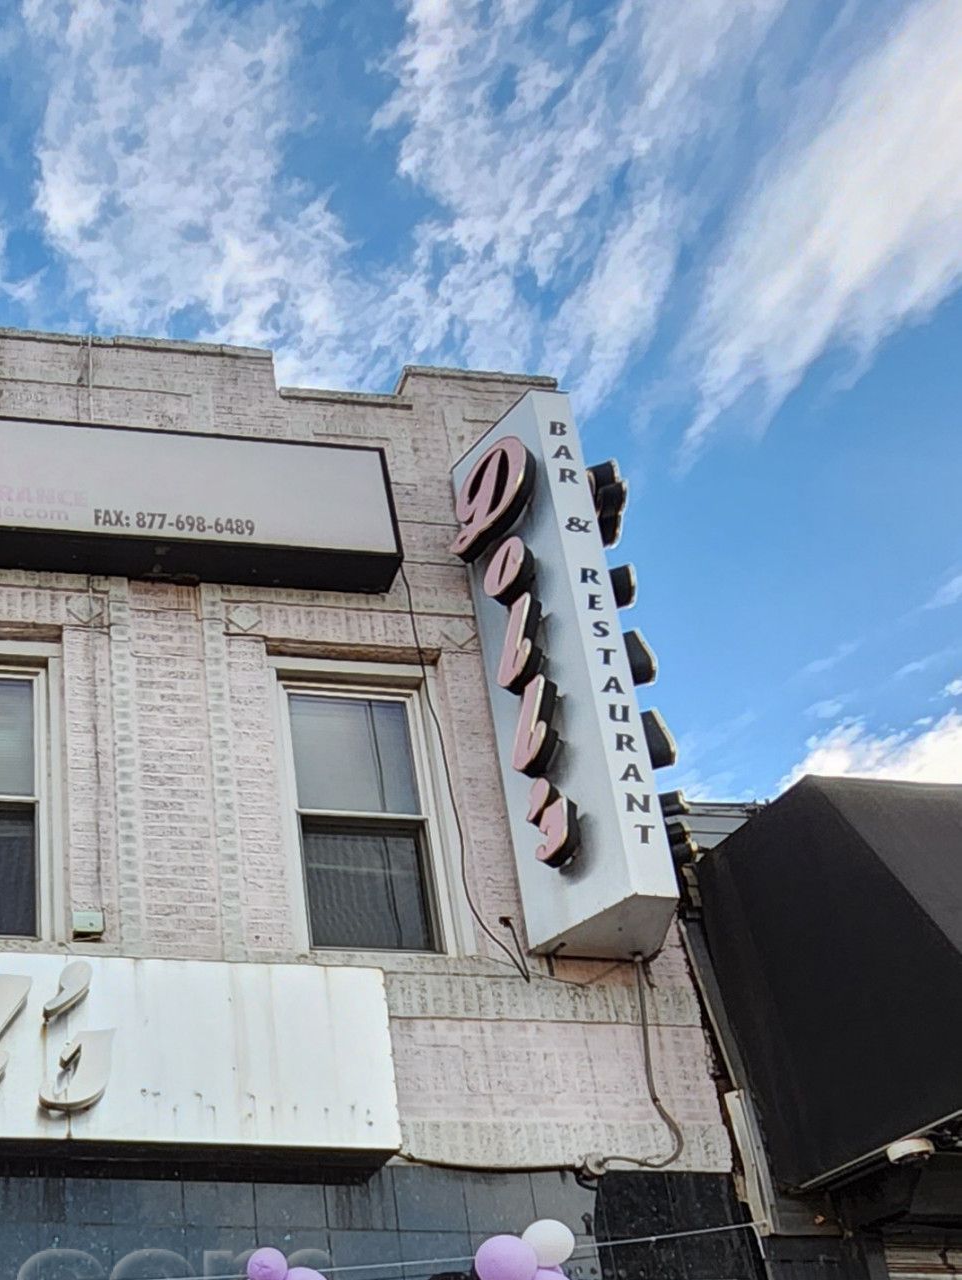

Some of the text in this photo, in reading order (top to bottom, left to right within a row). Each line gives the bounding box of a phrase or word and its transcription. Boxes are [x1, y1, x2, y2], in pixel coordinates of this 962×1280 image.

[93, 508, 256, 537] FAX: 877-698-6489
[549, 421, 656, 846] BAR & RESTAURANT
